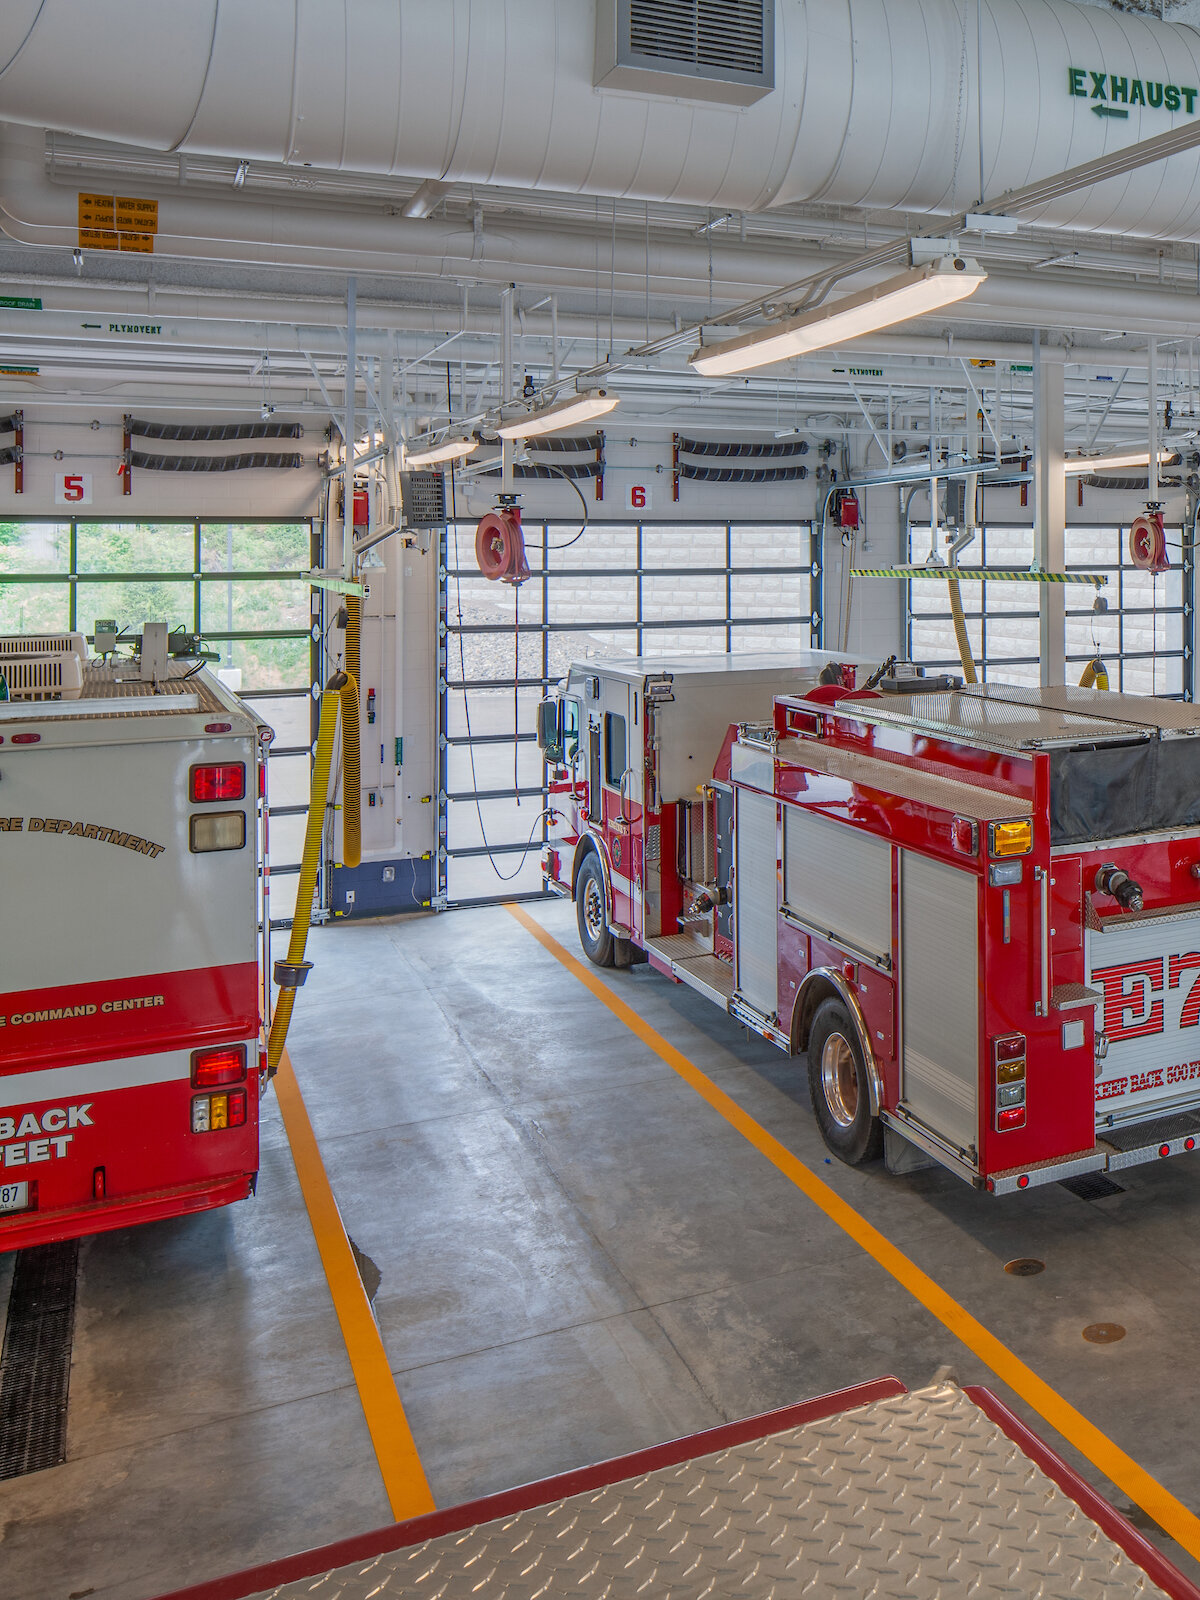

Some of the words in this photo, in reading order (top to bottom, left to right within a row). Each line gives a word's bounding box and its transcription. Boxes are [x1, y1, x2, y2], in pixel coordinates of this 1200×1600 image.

[1068, 67, 1198, 114] EXHAUST
[109, 323, 162, 335] PLYMOVENT
[64, 475, 84, 501] 5
[631, 486, 646, 508] 6
[28, 817, 166, 859] DEPARTMENT
[10, 1004, 98, 1026] COMMAND
[101, 995, 165, 1013] CENTER
[1095, 1076, 1129, 1101] KEEP
[1130, 1068, 1164, 1093] BACK
[0, 1103, 94, 1140] BACK
[0, 1186, 18, 1203] 87
